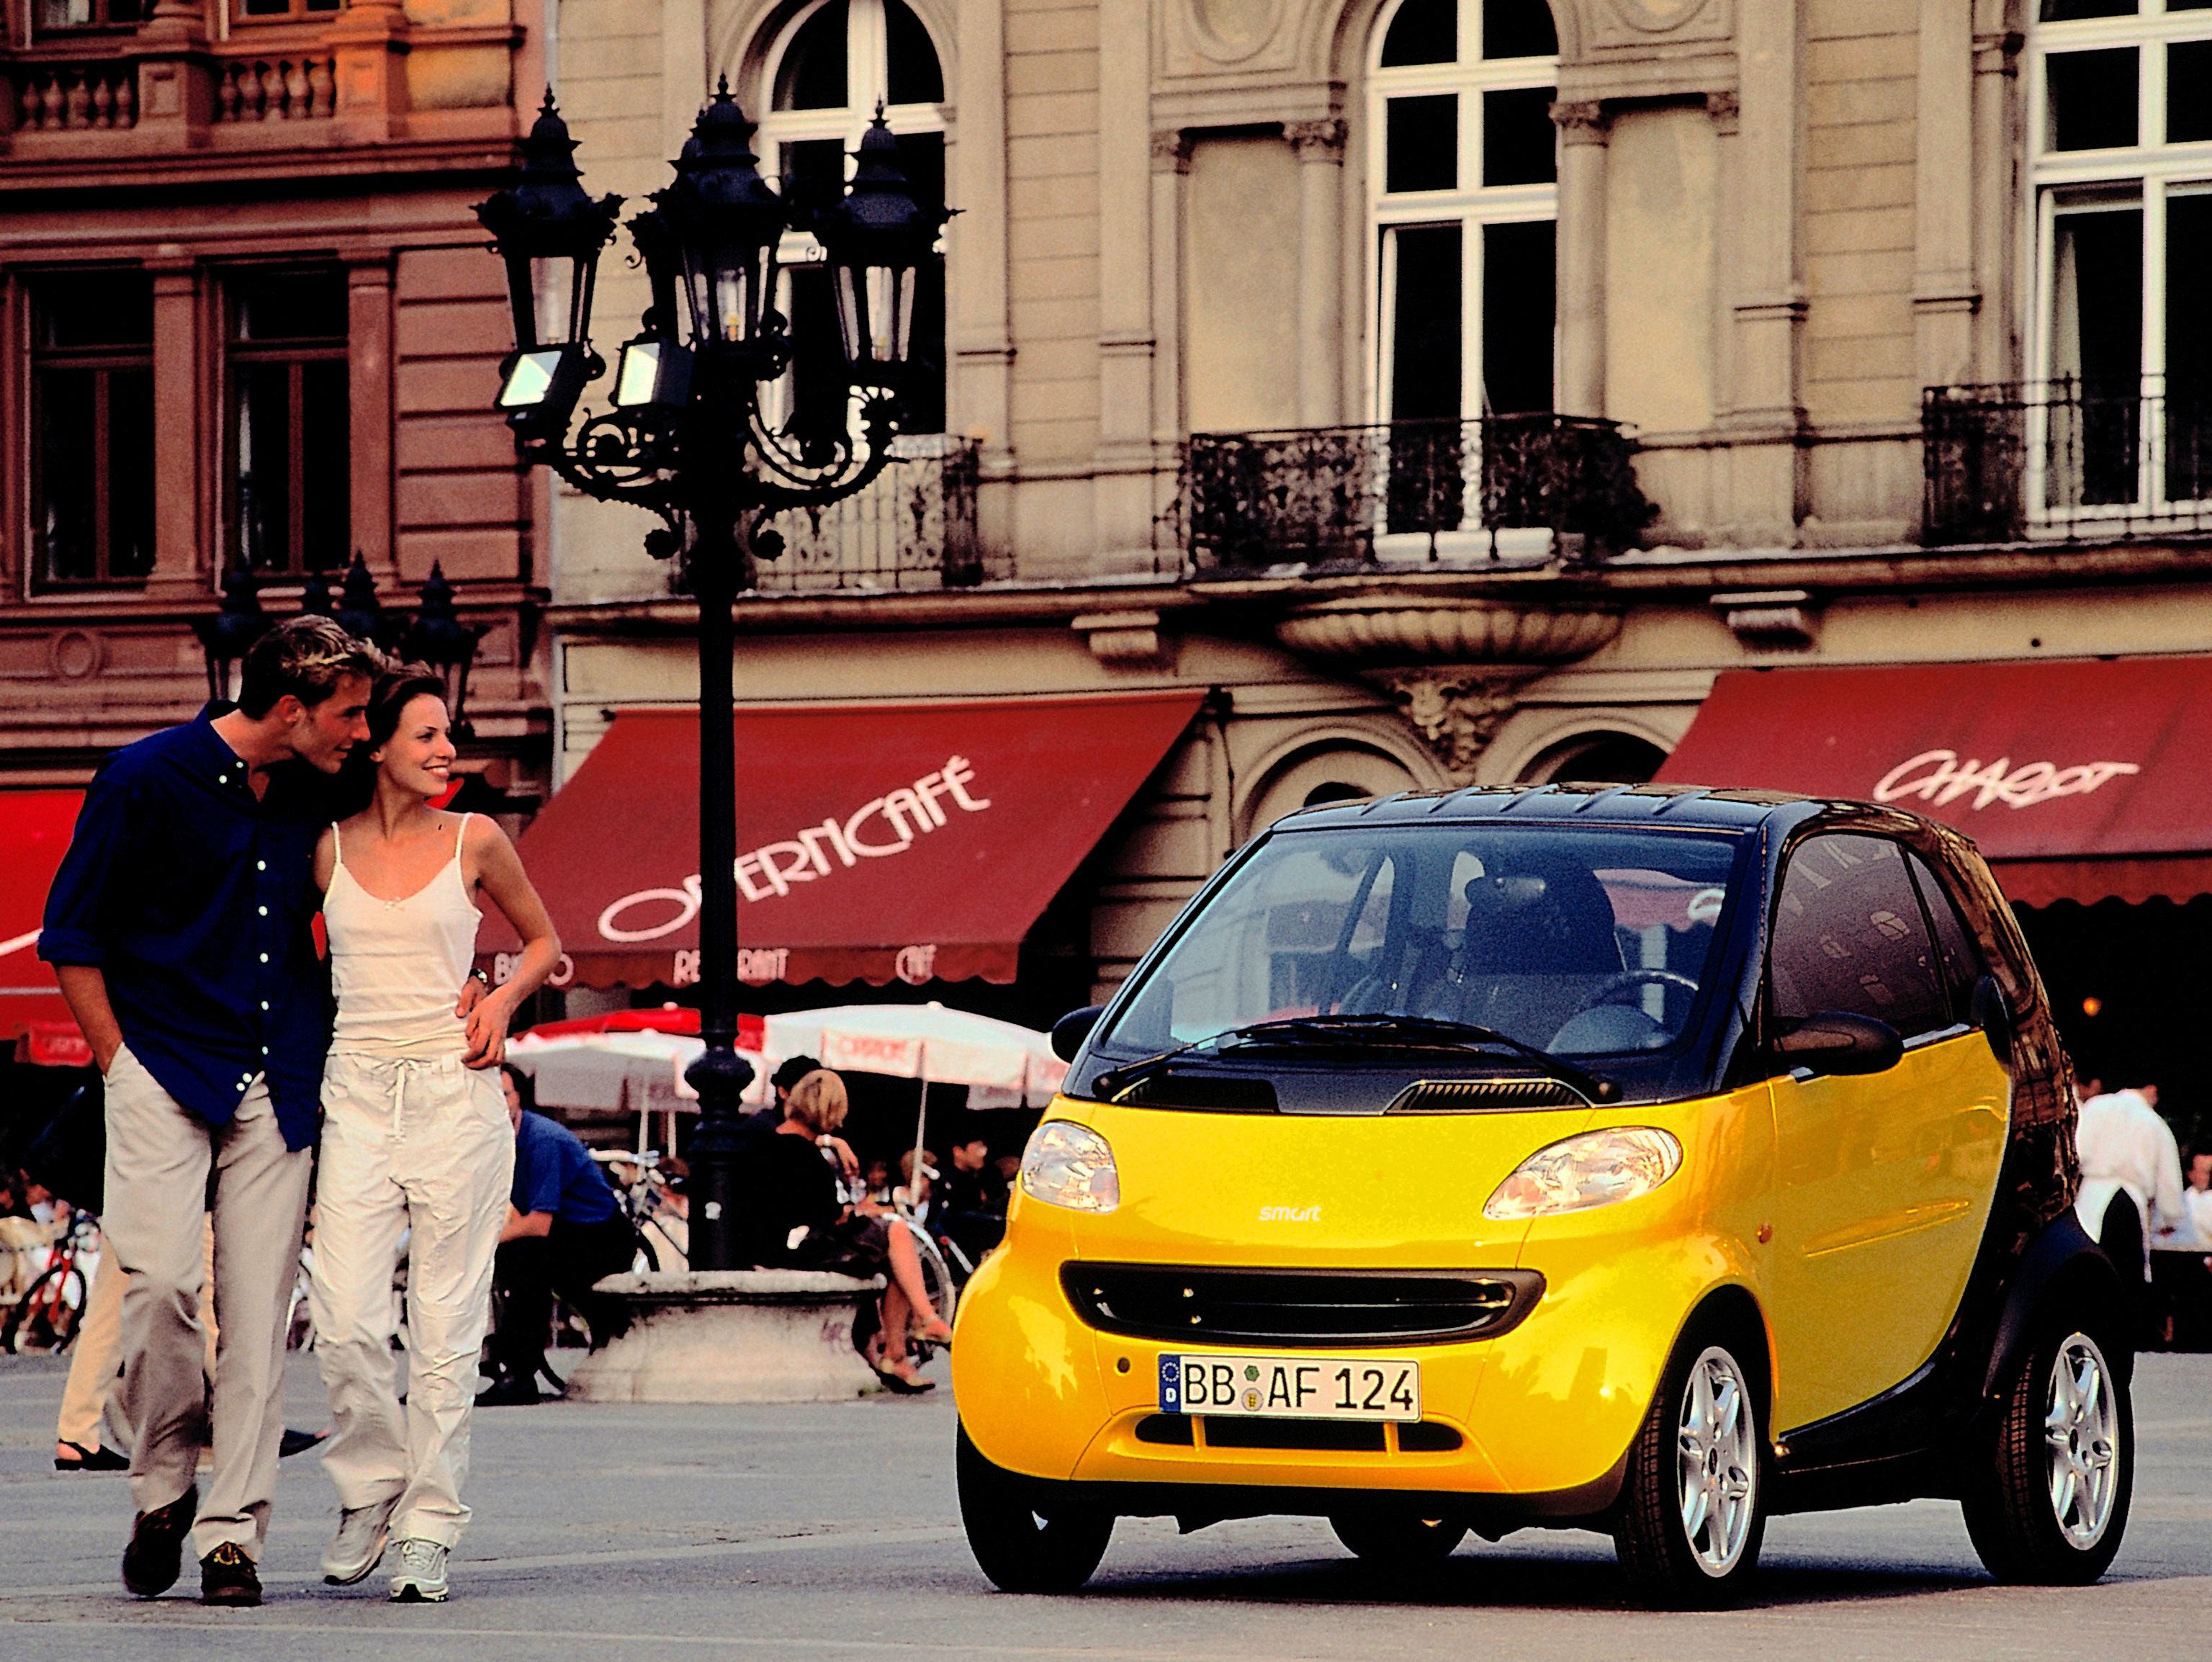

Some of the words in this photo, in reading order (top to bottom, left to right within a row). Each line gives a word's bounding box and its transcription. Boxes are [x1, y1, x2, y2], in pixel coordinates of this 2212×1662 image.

[598, 755, 992, 942] OERNCAFÉ
[1259, 1205, 1323, 1222] smart
[1184, 1363, 1236, 1405] BB
[1268, 1366, 1320, 1408] AF
[1335, 1367, 1413, 1411] 124
